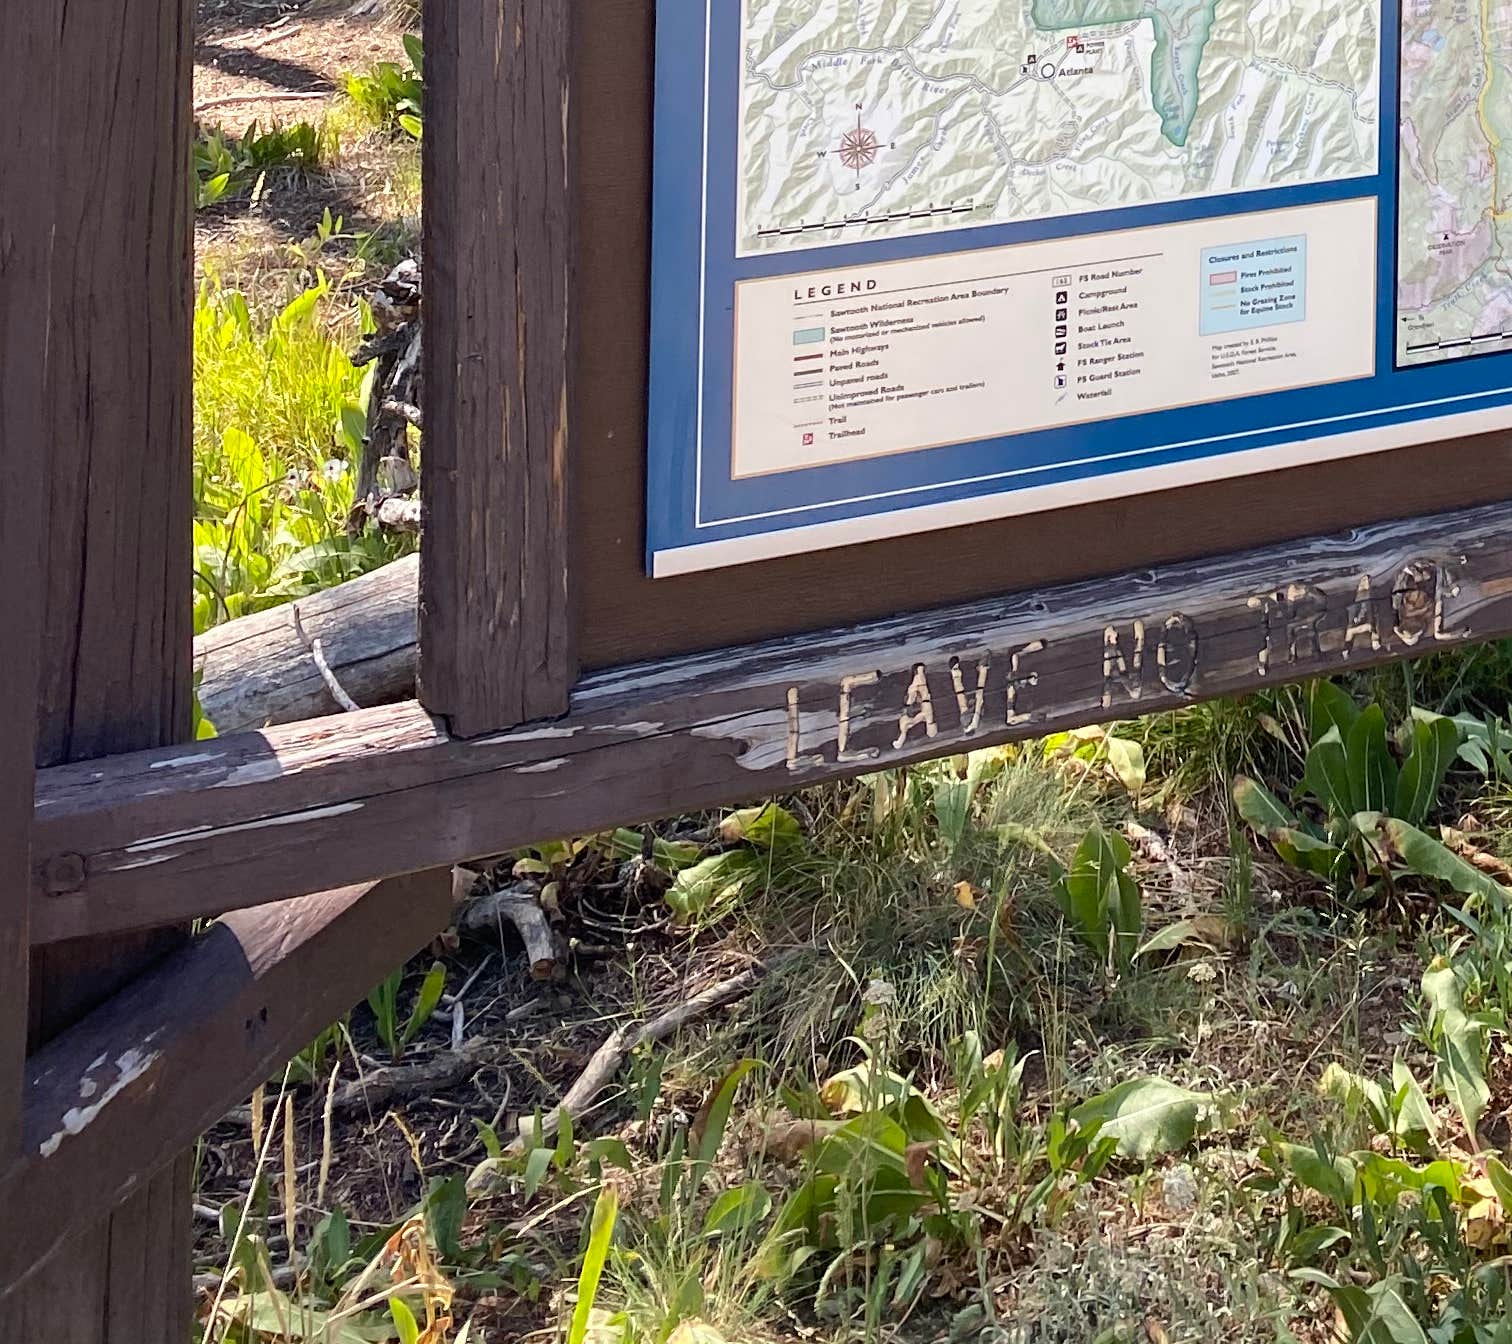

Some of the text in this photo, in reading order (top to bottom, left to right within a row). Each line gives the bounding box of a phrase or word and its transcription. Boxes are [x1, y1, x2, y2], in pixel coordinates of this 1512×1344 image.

[794, 280, 877, 300] LEGEND
[786, 638, 1048, 771] LEAVE
[1101, 613, 1201, 709] NO
